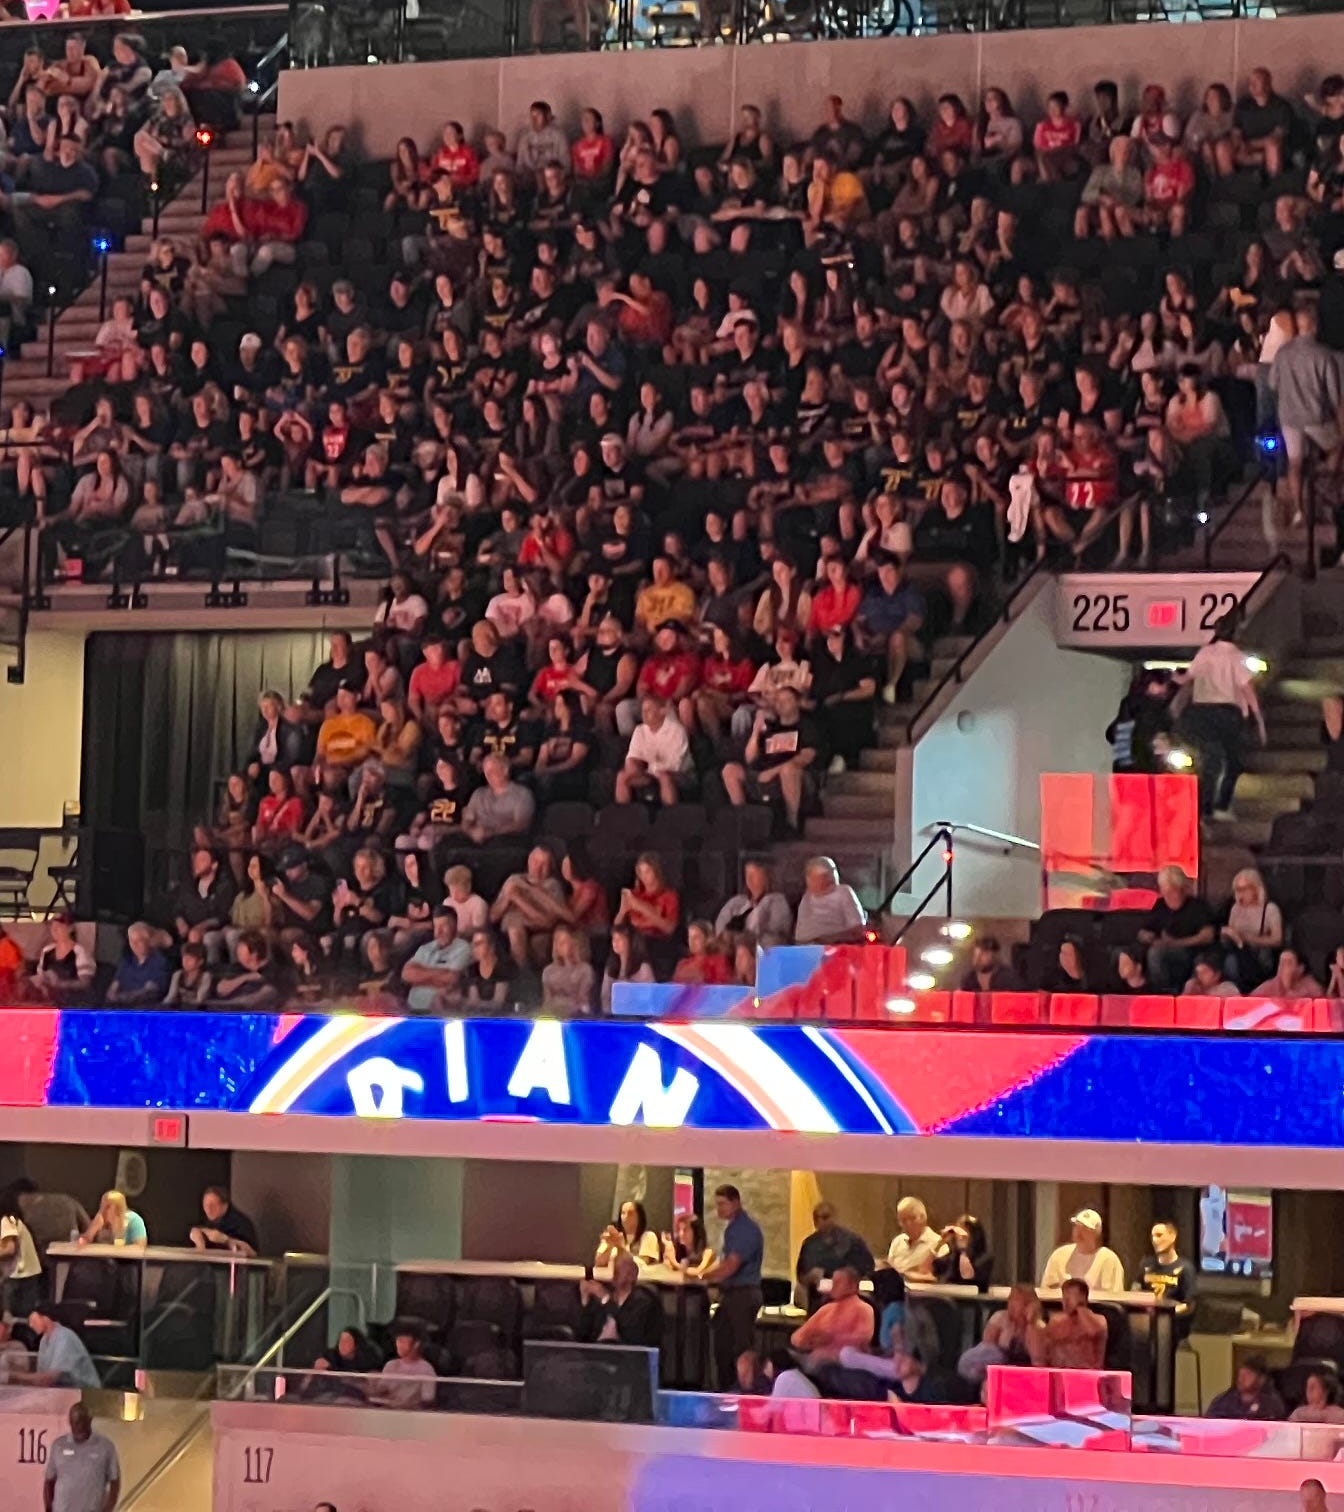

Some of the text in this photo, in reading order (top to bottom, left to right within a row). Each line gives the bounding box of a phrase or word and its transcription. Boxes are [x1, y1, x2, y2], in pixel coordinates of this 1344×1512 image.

[1072, 593, 1240, 632] 225 22
[18, 1428, 47, 1465] 116
[243, 1446, 274, 1484] 117
